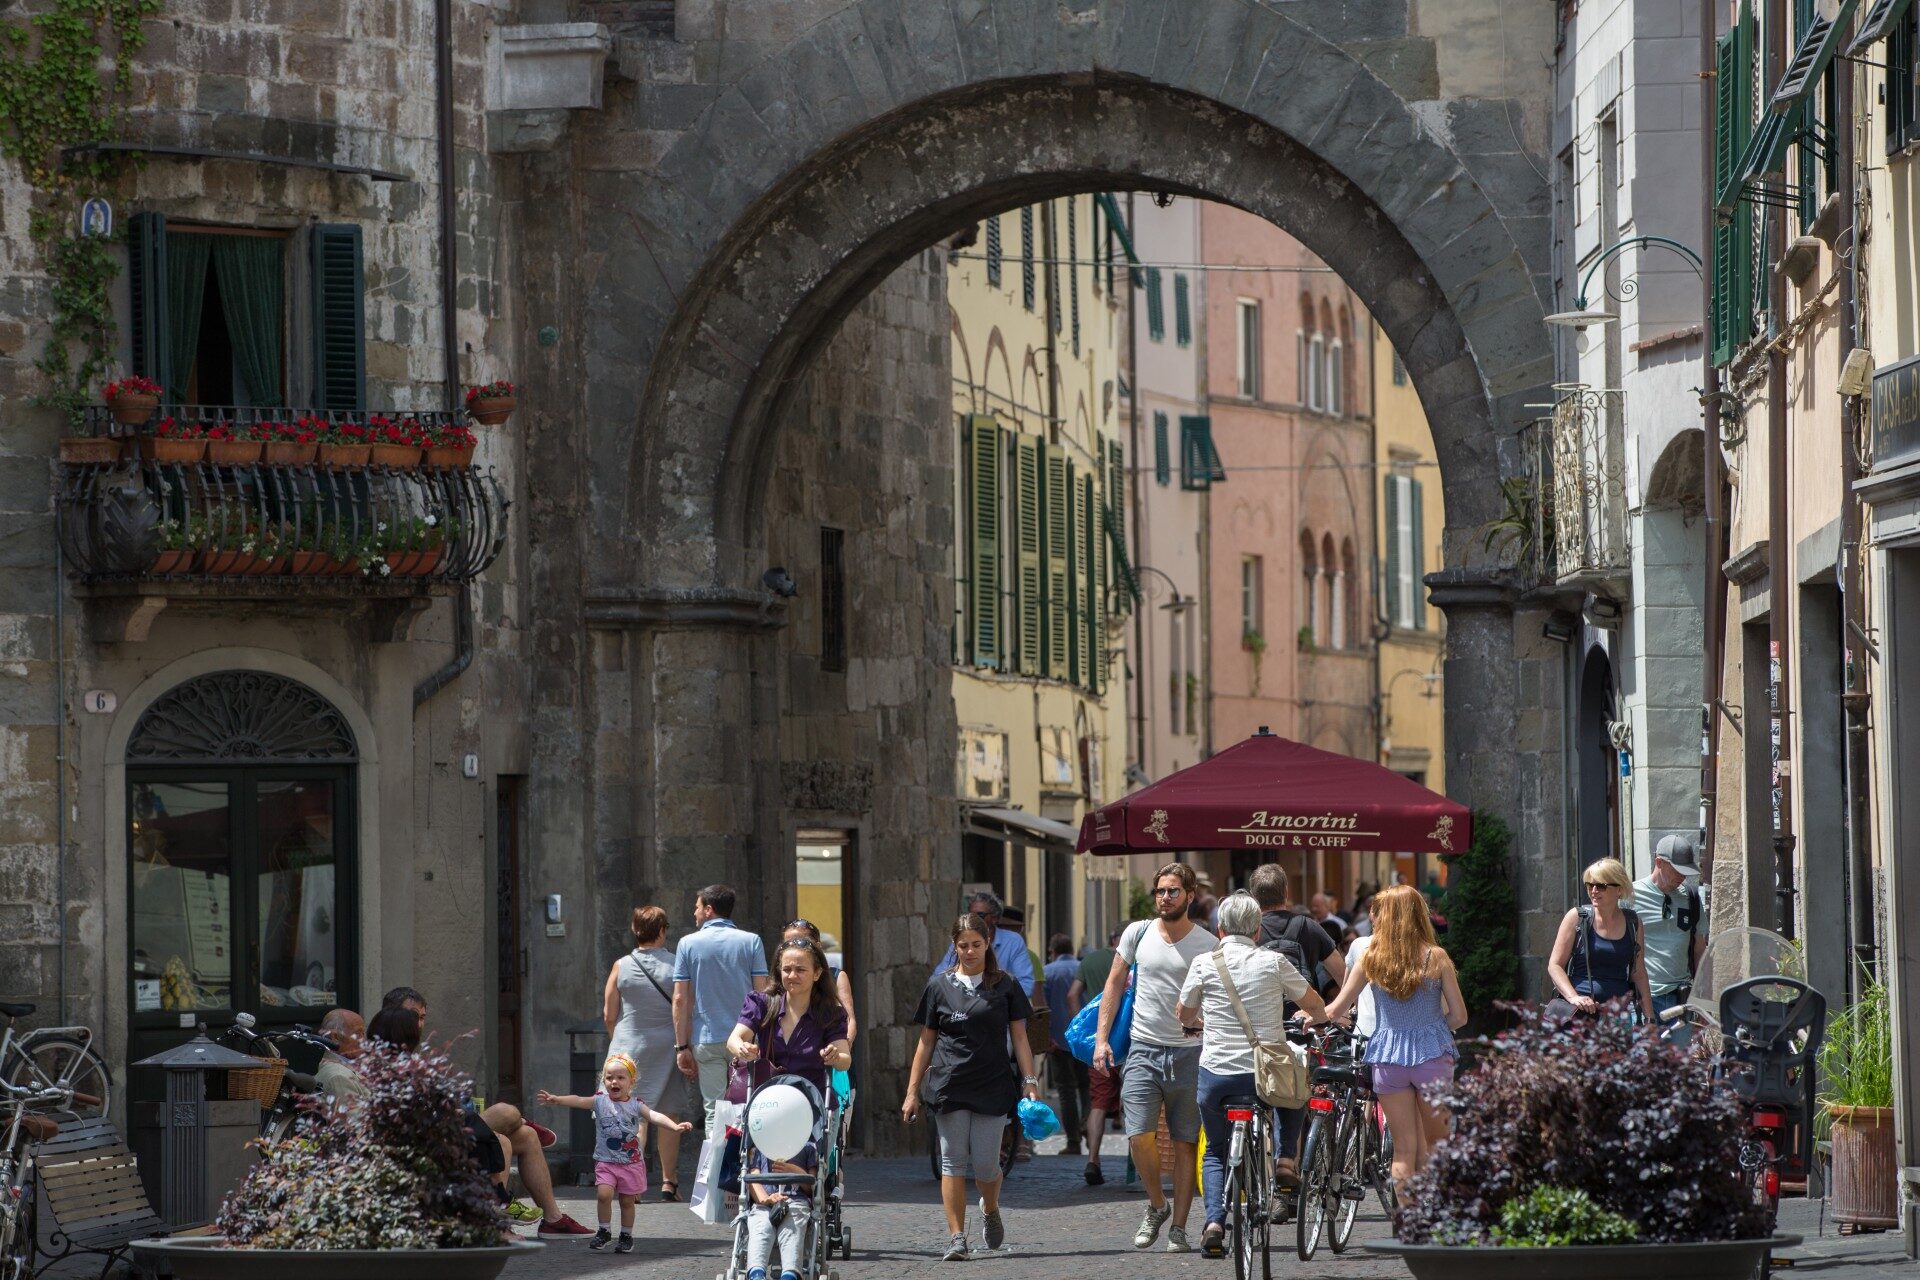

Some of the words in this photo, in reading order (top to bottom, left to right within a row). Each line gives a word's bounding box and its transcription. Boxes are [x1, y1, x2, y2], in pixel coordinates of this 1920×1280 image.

[1877, 372, 1901, 432] CASA
[96, 691, 106, 710] 6
[1240, 810, 1358, 830] Amorini
[1245, 834, 1285, 846] DOLCI
[1292, 835, 1302, 846] &
[1308, 836, 1351, 847] CAFFE'
